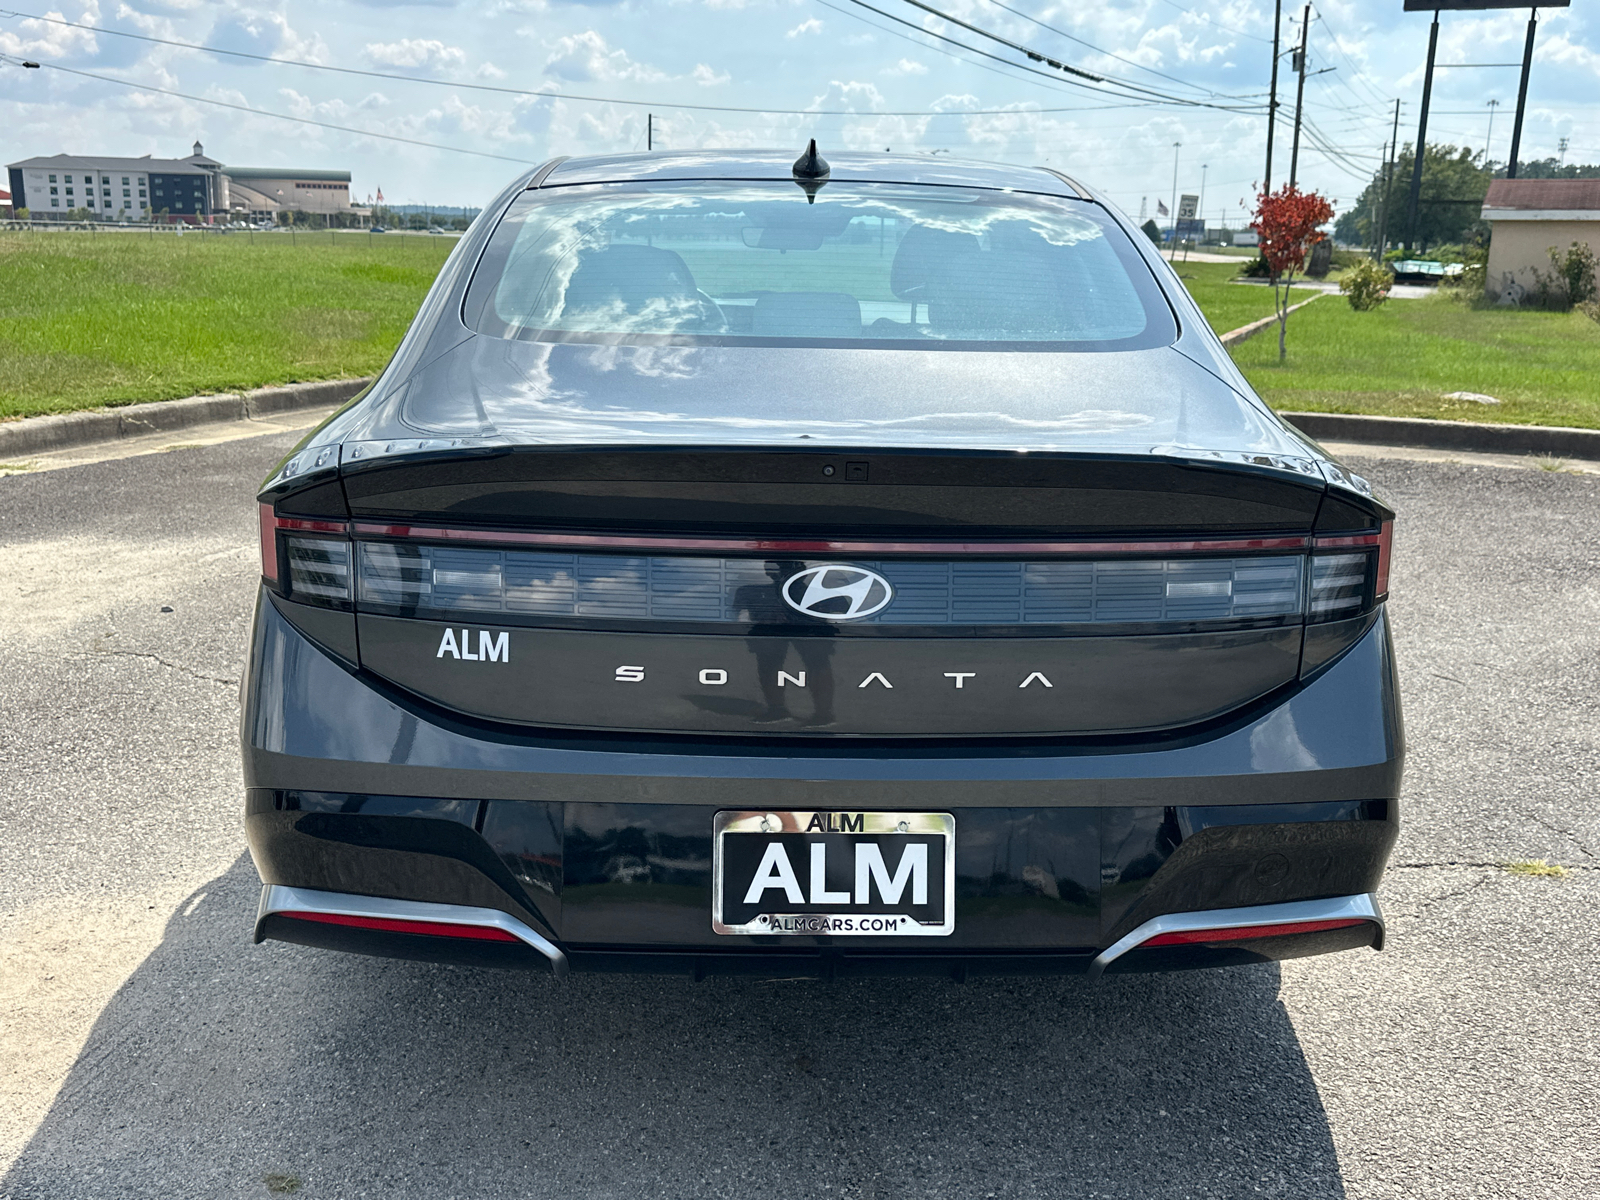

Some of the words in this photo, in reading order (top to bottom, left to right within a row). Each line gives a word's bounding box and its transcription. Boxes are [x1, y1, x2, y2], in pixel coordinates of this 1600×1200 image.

[1180, 208, 1194, 218] 35
[437, 628, 510, 663] ALM
[614, 665, 1053, 689] SONATA
[806, 813, 864, 833] ALM
[743, 842, 928, 904] ALM
[770, 918, 897, 932] ALMCARS.COM
